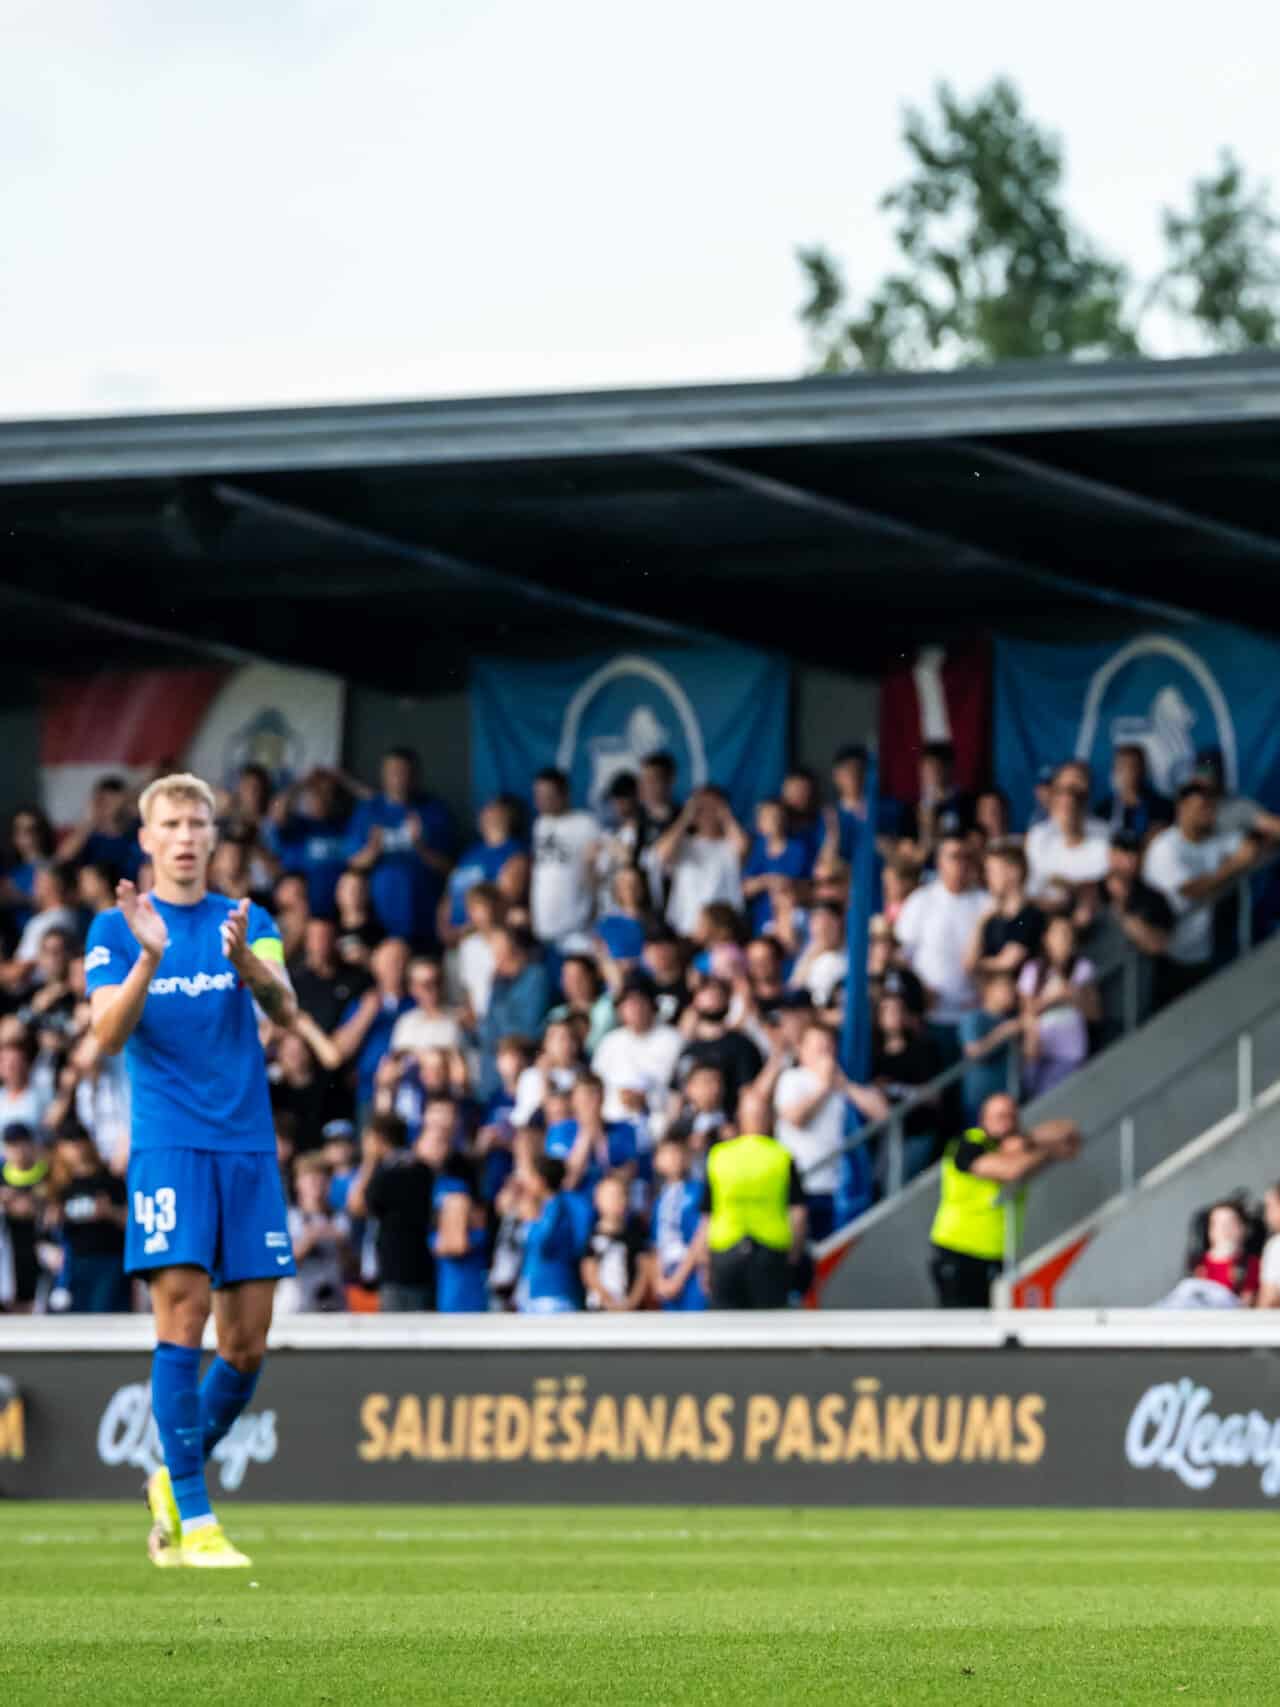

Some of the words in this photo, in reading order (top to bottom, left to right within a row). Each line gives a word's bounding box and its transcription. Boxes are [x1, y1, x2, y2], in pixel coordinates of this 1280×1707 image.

[134, 1187, 176, 1233] 43
[358, 1376, 734, 1464] SALIEDĒŠANAS
[743, 1376, 1046, 1464] PASĀKUMS
